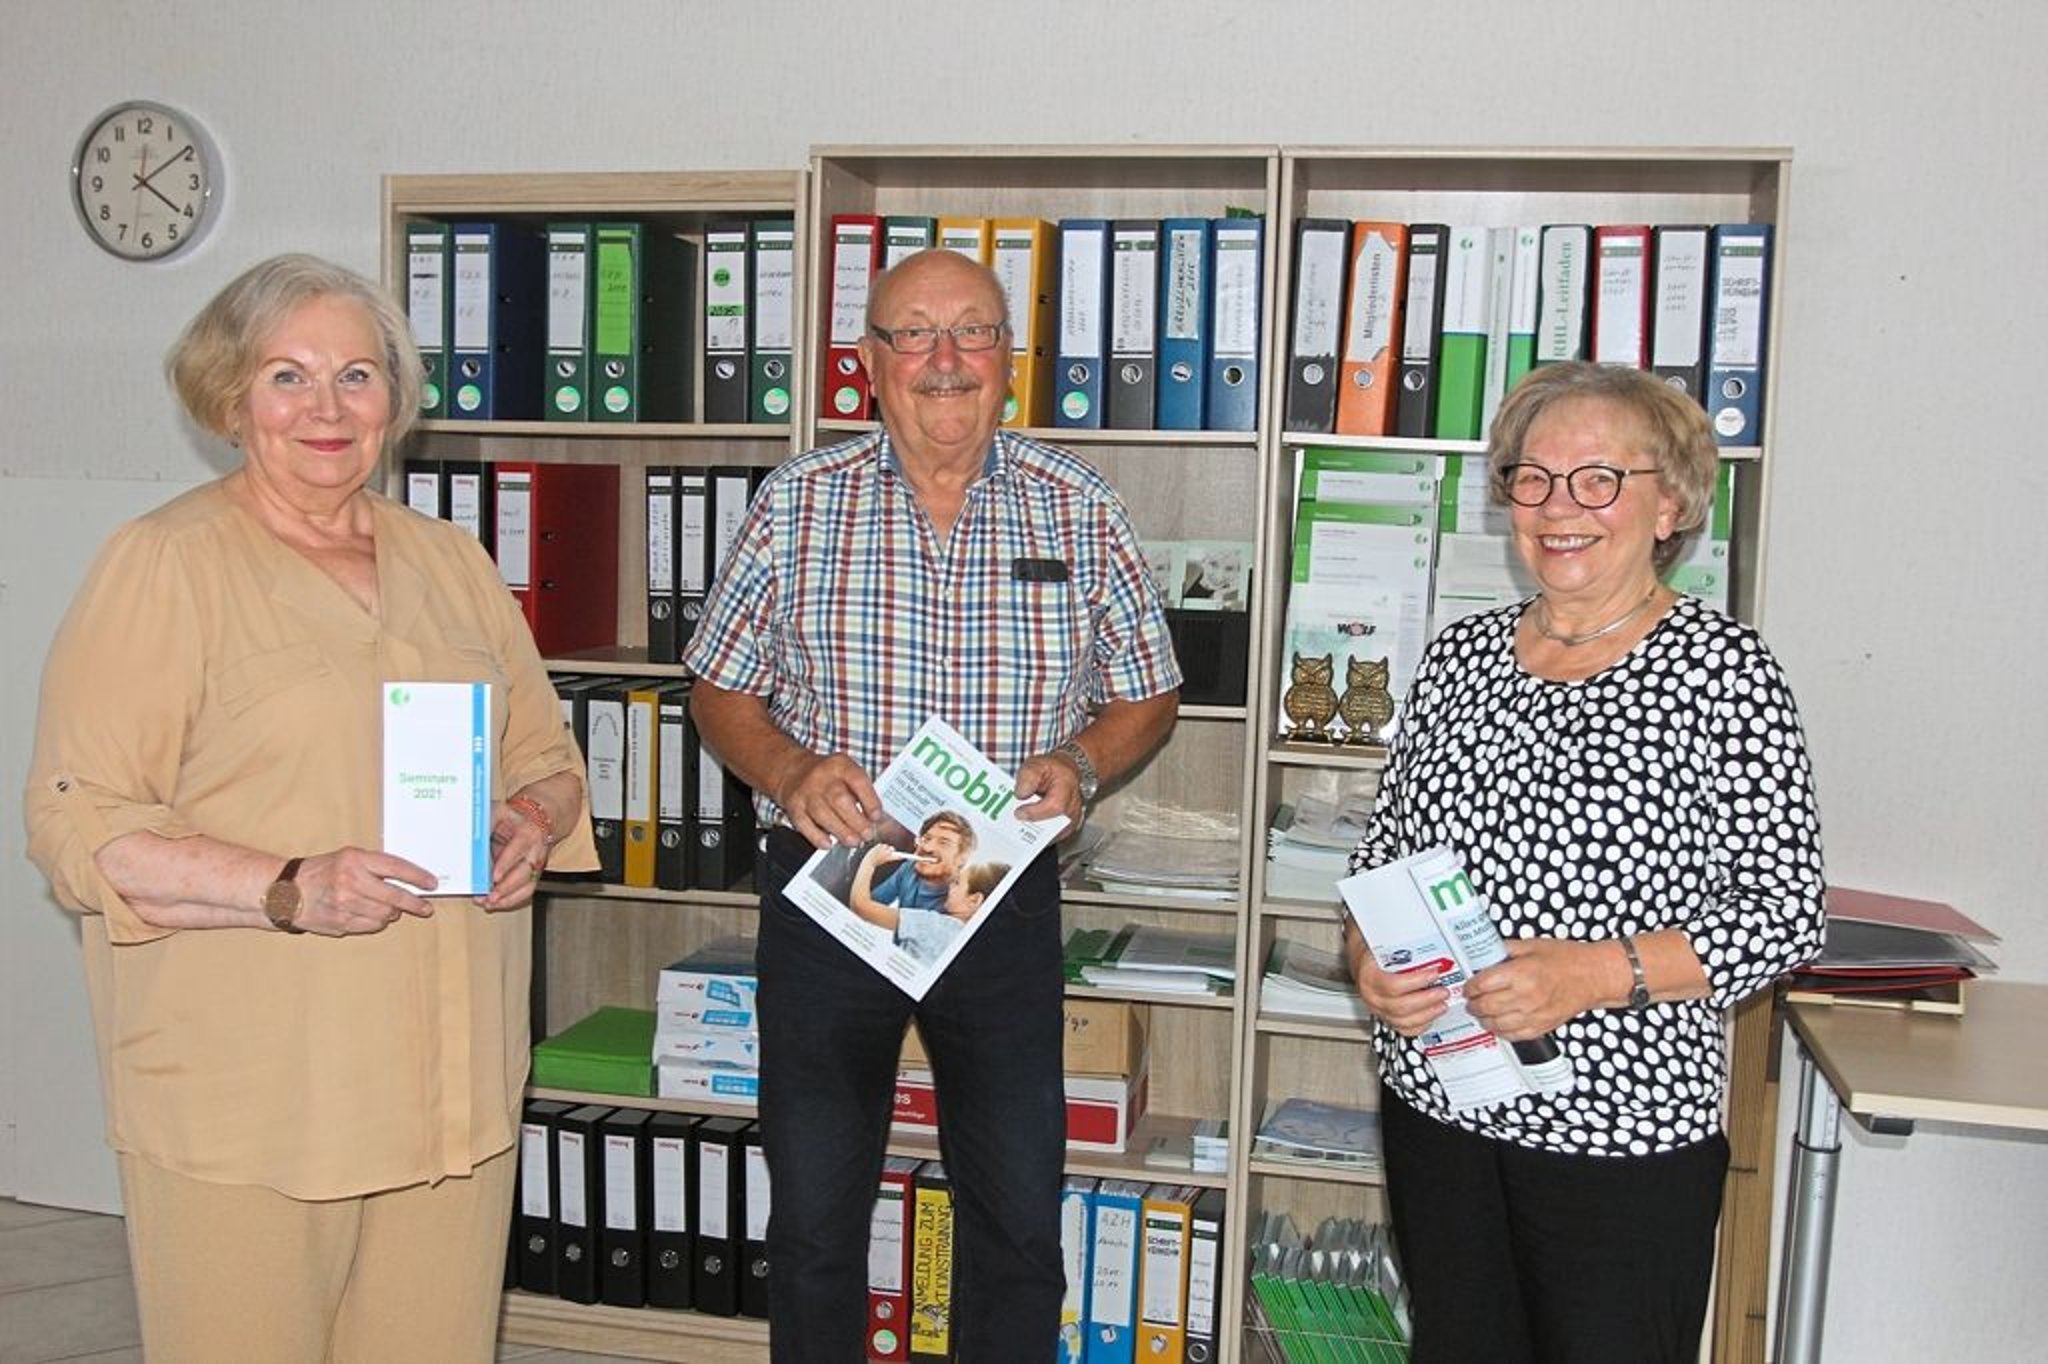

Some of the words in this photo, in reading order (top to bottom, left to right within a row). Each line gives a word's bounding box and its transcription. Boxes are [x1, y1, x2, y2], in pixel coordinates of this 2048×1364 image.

[115, 127, 125, 141] 11
[137, 118, 153, 134] 12
[167, 125, 173, 141] 1
[98, 147, 111, 162] 10
[184, 145, 195, 161] 2
[92, 176, 103, 192] 9
[189, 174, 199, 190] 3
[100, 205, 111, 220] 8
[183, 204, 194, 218] 4
[118, 224, 128, 240] 7
[168, 224, 178, 240] 5
[141, 233, 153, 248] 6
[399, 771, 458, 784] Seminare
[912, 735, 1014, 821] mobil
[413, 788, 442, 799] 2021
